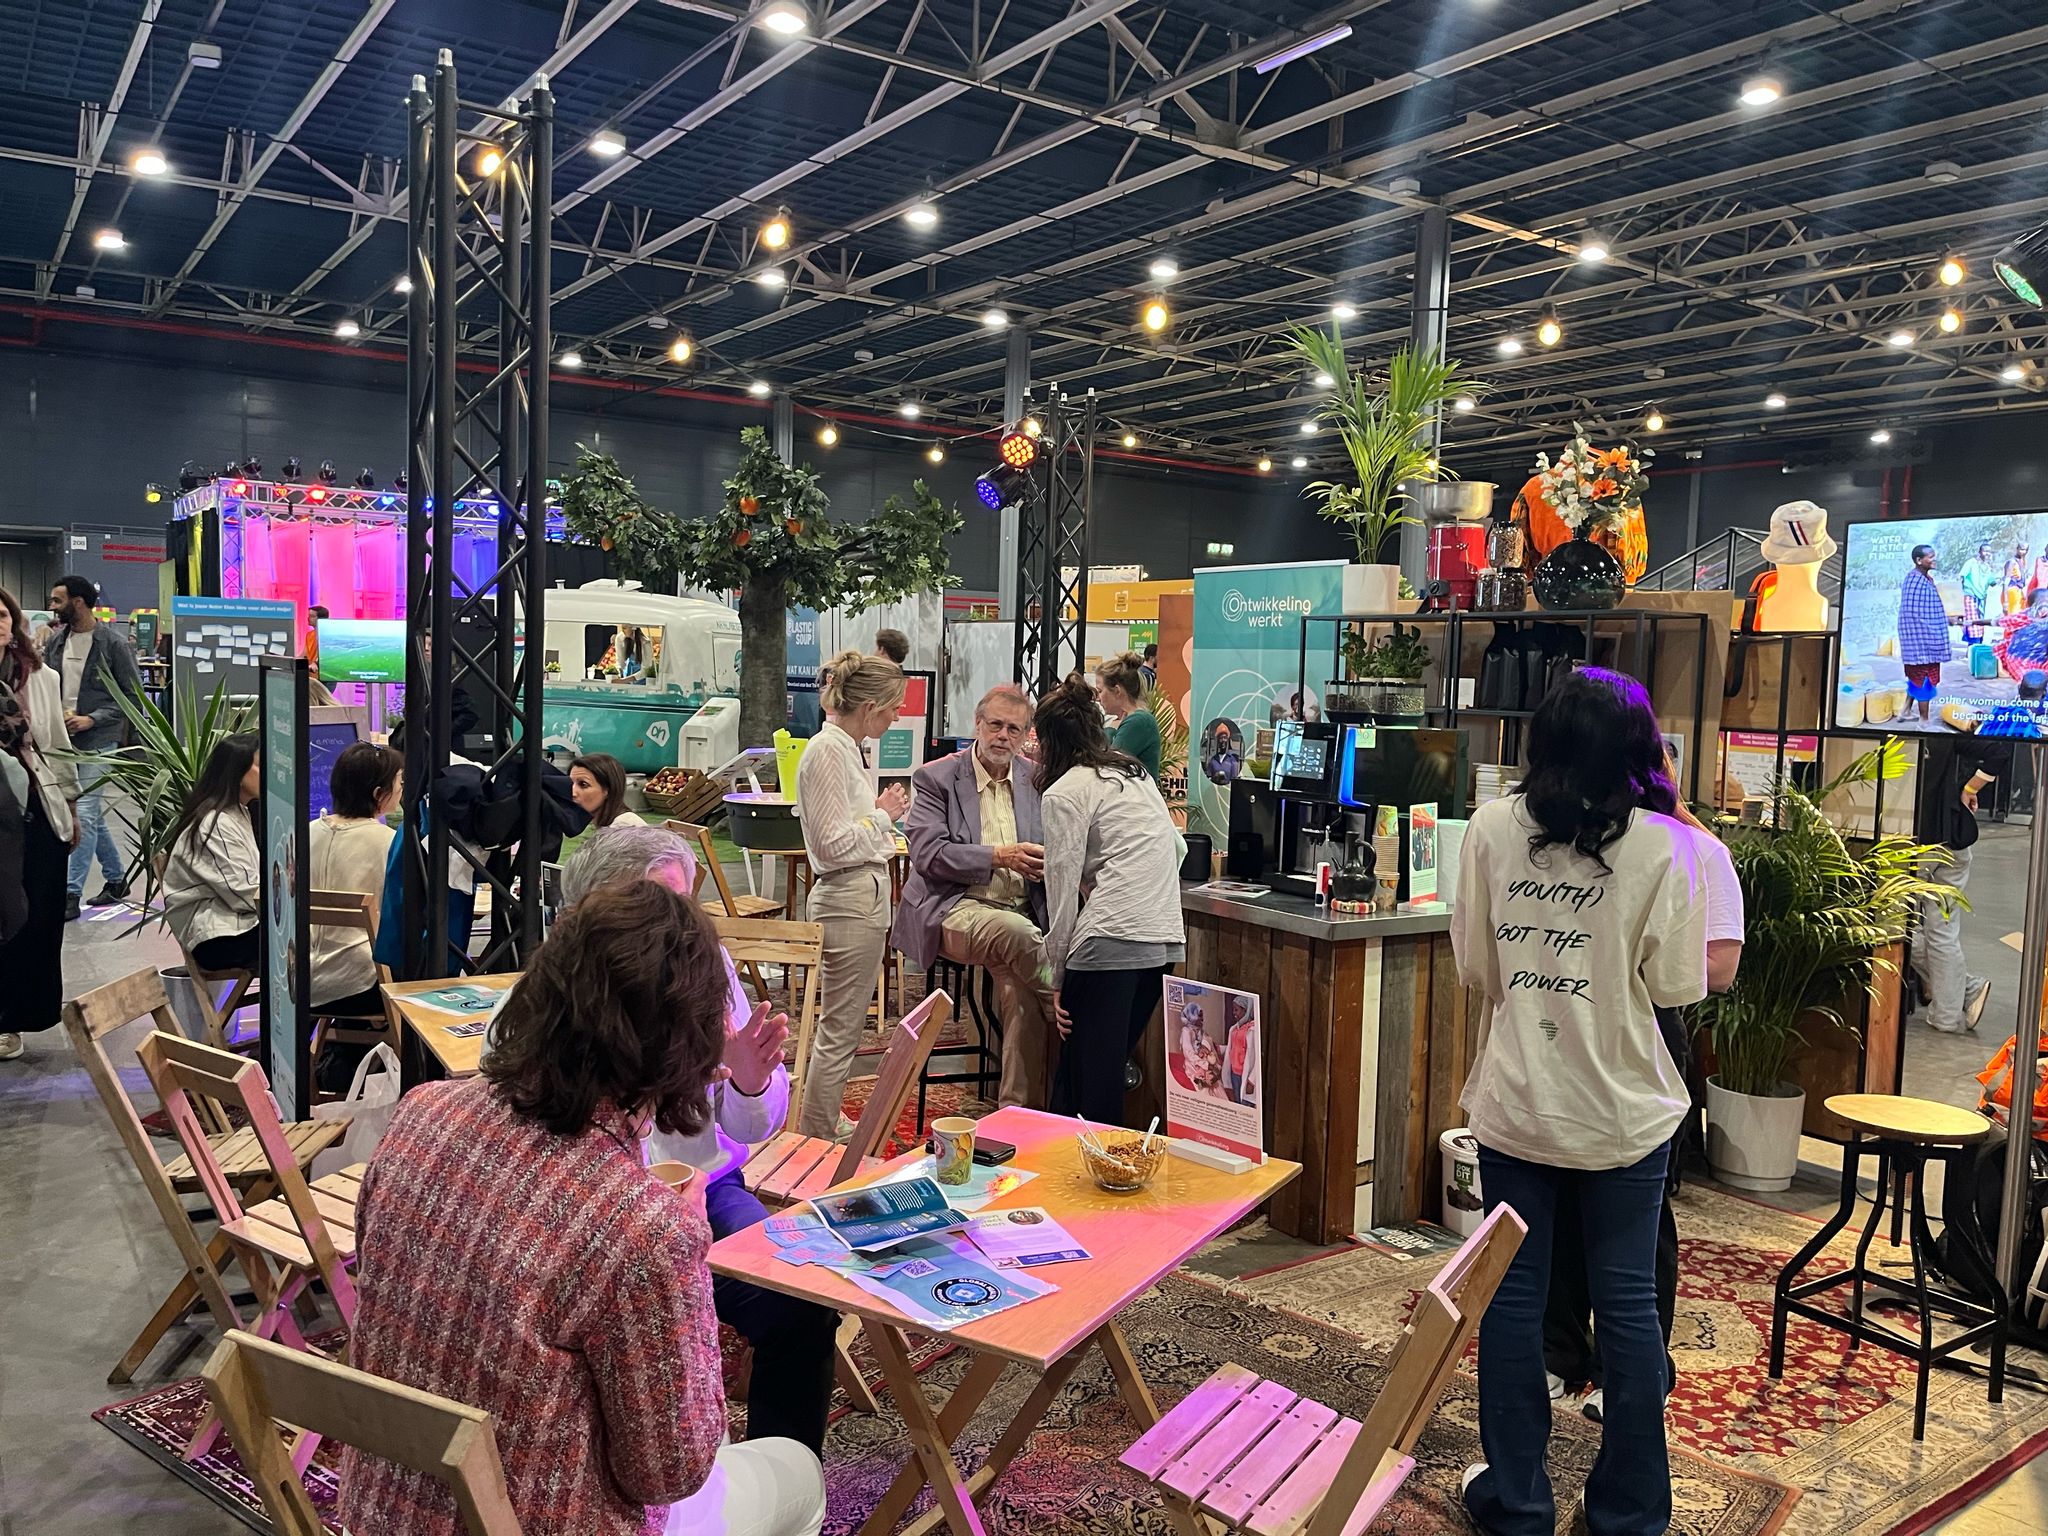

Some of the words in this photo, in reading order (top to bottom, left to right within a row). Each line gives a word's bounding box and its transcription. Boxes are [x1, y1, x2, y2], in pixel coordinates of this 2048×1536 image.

[1871, 535, 1902, 544] WATER
[1228, 595, 1312, 615] Ontwikkeling
[1248, 612, 1283, 627] werkt
[795, 633, 811, 645] SOUP
[798, 666, 810, 676] KAN
[1969, 698, 2007, 706] women
[2010, 699, 2039, 708] come
[1952, 711, 1995, 721] because
[1998, 713, 2009, 721] of
[2012, 713, 2030, 722] the
[1508, 879, 1605, 914] YOU(TH)
[1496, 922, 1538, 944] GOT
[1543, 929, 1592, 957] THE
[1509, 971, 1598, 1006] POWER
[958, 1278, 987, 1288] GLOBAL
